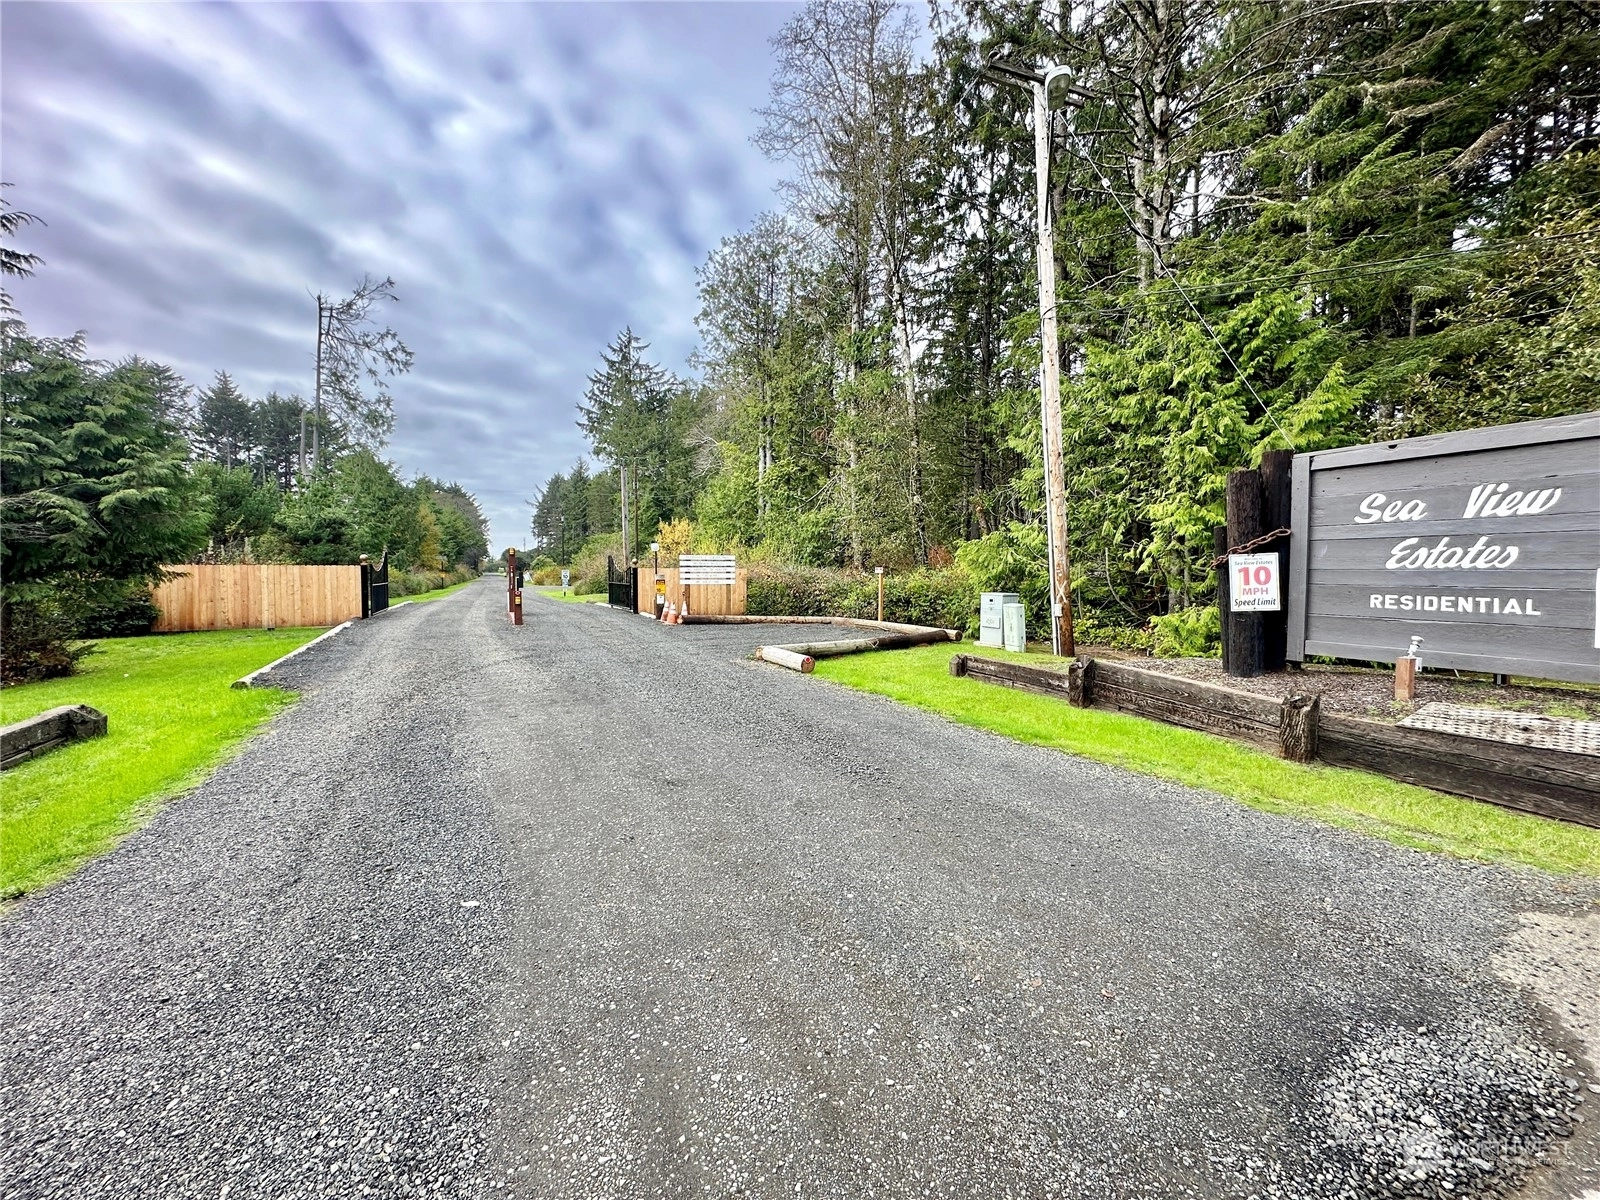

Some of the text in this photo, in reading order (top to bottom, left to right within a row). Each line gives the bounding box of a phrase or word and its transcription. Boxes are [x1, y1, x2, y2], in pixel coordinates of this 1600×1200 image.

[1354, 482, 1562, 524] Sea View
[1385, 536, 1520, 570] Estates
[1238, 566, 1271, 586] 10
[1242, 587, 1269, 596] MPH
[1234, 597, 1276, 608] Speed Limit
[1369, 594, 1542, 616] RESIDENTIAL
